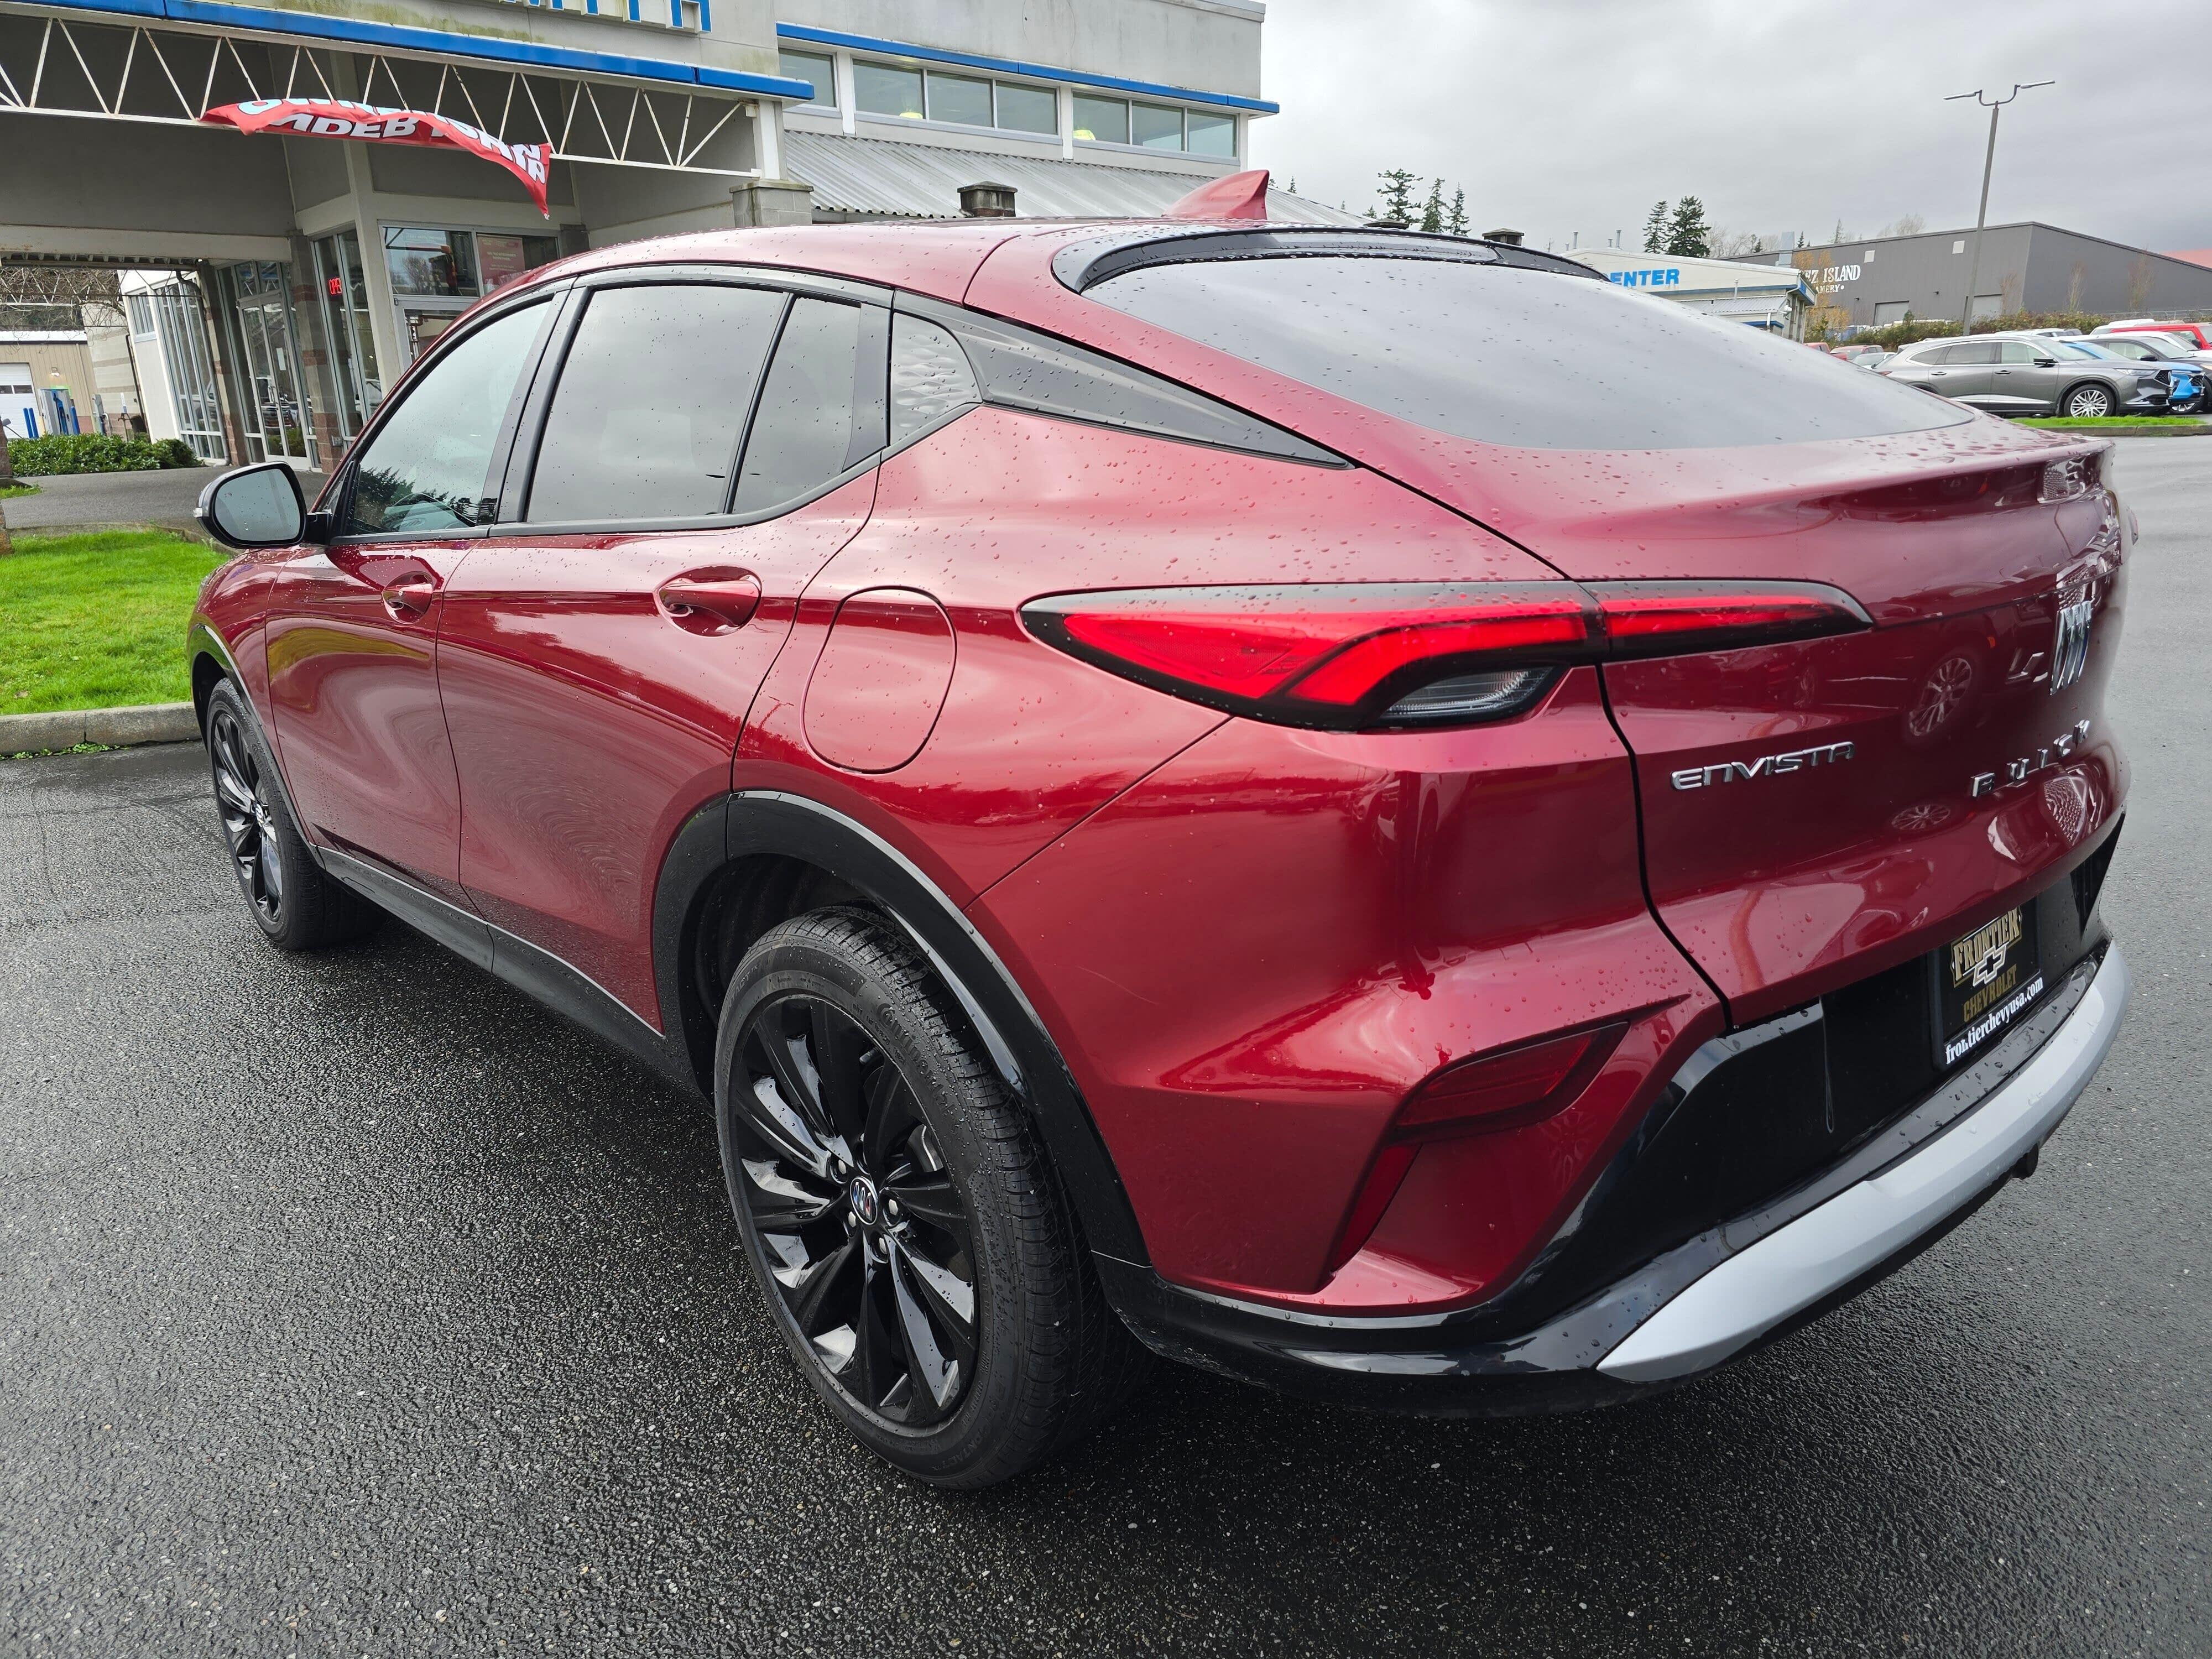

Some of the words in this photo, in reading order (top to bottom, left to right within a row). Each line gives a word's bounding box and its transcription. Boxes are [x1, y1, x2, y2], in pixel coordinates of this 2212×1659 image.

[1603, 269, 1680, 287] ENTER
[1823, 264, 1861, 284] ISLAND
[1671, 740, 1855, 791] ENVISTA
[1970, 719, 2090, 797] BUICK
[1953, 905, 2020, 981] FRONTIER
[1963, 964, 2017, 1023] CHEVROLET
